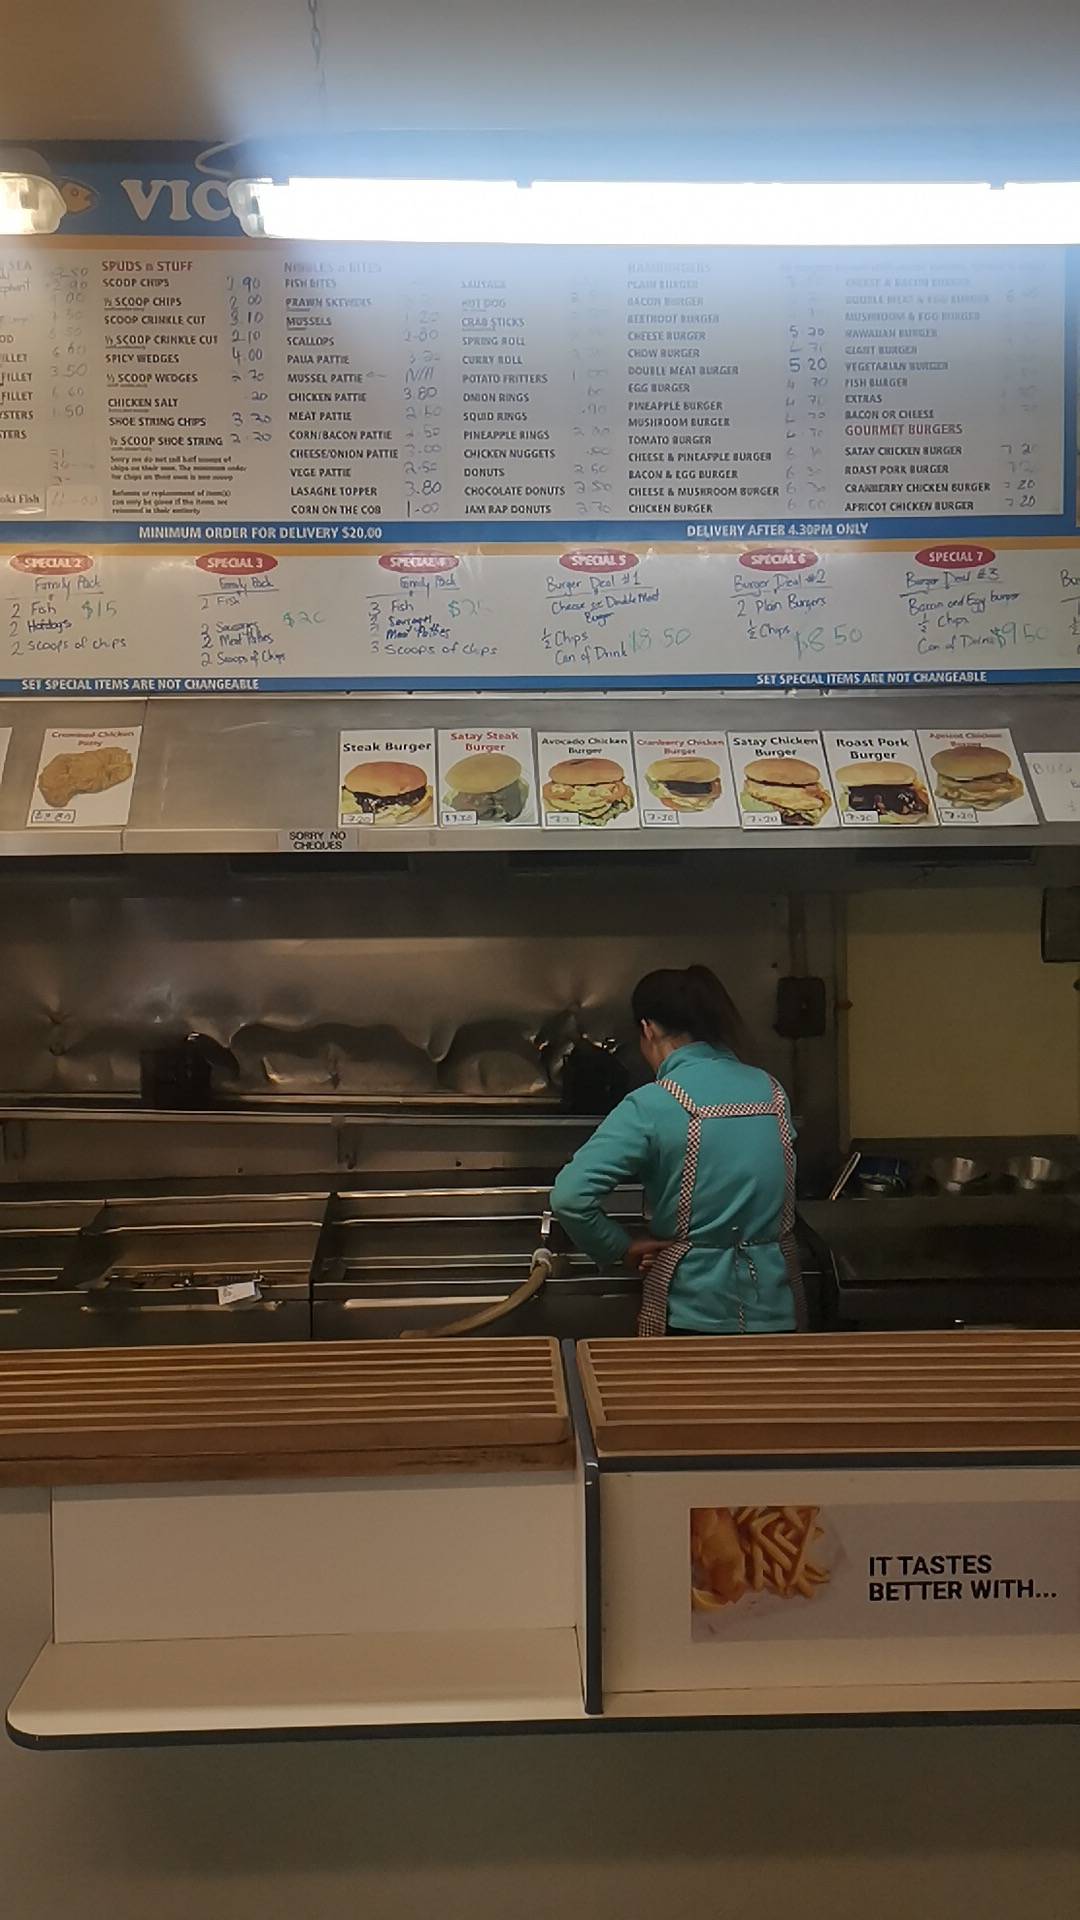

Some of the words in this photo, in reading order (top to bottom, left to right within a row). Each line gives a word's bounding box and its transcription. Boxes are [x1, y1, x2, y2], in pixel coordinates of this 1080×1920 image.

[102, 278, 138, 288] SCOOP
[140, 278, 170, 288] CHIPS
[104, 315, 139, 325] SCOOP
[141, 315, 184, 325] CRINKLE
[186, 315, 206, 325] CUT
[286, 336, 336, 346] SCALLOPS
[462, 336, 497, 346] SPRING
[501, 336, 526, 346] ROLL
[627, 331, 664, 341] CHEESE
[666, 331, 706, 341] BURGER
[627, 349, 659, 358] CHOW
[660, 349, 700, 358] BURGER
[105, 354, 134, 364] SPICY
[139, 354, 180, 364] WEDGES
[462, 355, 495, 364] CURRY
[498, 355, 523, 364] ROLL
[628, 366, 666, 376] DOUBLE
[669, 366, 696, 376] MEAT
[699, 366, 739, 376] BURGER
[287, 373, 328, 383] MUSSEL
[331, 373, 364, 383] PATTIE
[462, 374, 501, 383] POTATO
[503, 374, 548, 383] FRITTERS
[845, 378, 867, 387] FISH
[869, 378, 909, 387] BURGER
[628, 383, 648, 393] EGG
[651, 383, 691, 393] BURGER
[288, 392, 331, 402] CHICKEN
[334, 392, 368, 402] PATTIE
[463, 392, 496, 402] ONION
[499, 392, 530, 402] RINGS
[845, 394, 883, 403] EXTRAS
[108, 398, 152, 408] CHICKEN
[154, 398, 180, 408] SALT
[628, 401, 681, 411] PINEAPPLE
[683, 401, 723, 411] BURGER
[288, 411, 317, 421] MEAT
[320, 411, 353, 421] PATTIE
[463, 411, 494, 421] SQUID
[497, 411, 528, 421] RINGS
[845, 410, 878, 419] BACON
[881, 410, 896, 419] OR
[898, 410, 935, 419] CHEESE
[108, 417, 136, 427] SHOE
[139, 417, 175, 427] STRING
[177, 417, 207, 427] CHIPS
[628, 418, 688, 427] MUSHROOM
[691, 418, 730, 427] BURGER
[463, 430, 517, 440] PINEAPPLE
[520, 430, 550, 440] RINGS
[845, 424, 904, 436] GOURMET
[908, 424, 964, 436] BURGERS
[628, 435, 669, 445] TOMATO
[672, 435, 712, 445] BURGER
[366, 448, 399, 459] PATTIE
[463, 449, 507, 459] CHICKEN
[509, 449, 556, 459] NUGGETS
[845, 446, 876, 456] SATAY
[878, 446, 920, 456] CHICKEN
[923, 446, 962, 456] BURGER
[289, 467, 316, 477] VEGE
[319, 467, 352, 477] PATTIE
[464, 467, 505, 477] DONUTS
[845, 464, 877, 474] ROAST
[880, 464, 907, 474] PORK
[909, 464, 950, 474] BURGER
[290, 486, 338, 496] LASAGNE
[340, 486, 378, 496] TOPPER
[464, 486, 523, 496] CHOCOLATE
[525, 486, 566, 496] DONUTS
[845, 483, 903, 492] CRANBERRY
[906, 483, 948, 492] CHICKEN
[951, 483, 991, 492] BURGER
[291, 504, 319, 514] CORN
[322, 504, 337, 514] ON
[340, 504, 358, 514] THE
[628, 504, 671, 513] CHICKEN
[673, 504, 713, 513] BURGER
[845, 502, 887, 511] APRICOT
[889, 502, 932, 511] CHICKEN
[934, 502, 974, 511] BURGER
[139, 526, 201, 540] MINIMUM
[205, 526, 248, 540] ORDER
[252, 526, 276, 540] FOR
[280, 526, 339, 540] DELIVERY
[342, 526, 382, 540] $20.00
[687, 525, 745, 537] DELIVERY
[748, 524, 786, 536] AFTER
[788, 524, 834, 536] 4.30PM
[837, 523, 869, 535] ONLY
[928, 551, 974, 562] SPECIAL
[976, 551, 984, 562] 7
[208, 557, 254, 569] SPECIAL
[256, 557, 263, 569] 3
[756, 674, 777, 685] SET
[779, 674, 824, 685] SPECIAL
[826, 673, 861, 684] ITEMS
[863, 673, 884, 684] ARE
[886, 673, 909, 684] NOT
[911, 671, 987, 683] CHANGEABLE
[21, 679, 43, 690] SET
[45, 679, 92, 690] SPECIAL
[94, 679, 129, 690] ITEMS
[132, 679, 157, 690] ARE
[159, 678, 182, 690] NOT
[184, 678, 259, 690] CHANGEABLE
[451, 731, 484, 743] Satay
[486, 731, 519, 742] Steak
[541, 737, 585, 746] Avocado
[588, 737, 628, 746] Chicken
[342, 741, 381, 753] Steak
[385, 740, 432, 755] Burger
[733, 737, 769, 749] Satay
[772, 736, 819, 747] Chicken
[836, 738, 875, 748] Roast
[877, 737, 910, 748] Pork
[465, 742, 506, 754] Burger
[567, 746, 603, 757] Burger
[754, 748, 798, 760] Burger
[850, 750, 898, 761] Burger
[289, 831, 325, 841] SORRY
[331, 831, 347, 841] NO
[293, 841, 343, 850] CHEQUES
[869, 1556, 892, 1577] IT
[895, 1554, 993, 1576] TASTES
[869, 1580, 962, 1602] BETTER
[970, 1579, 1058, 1601] WITH...
